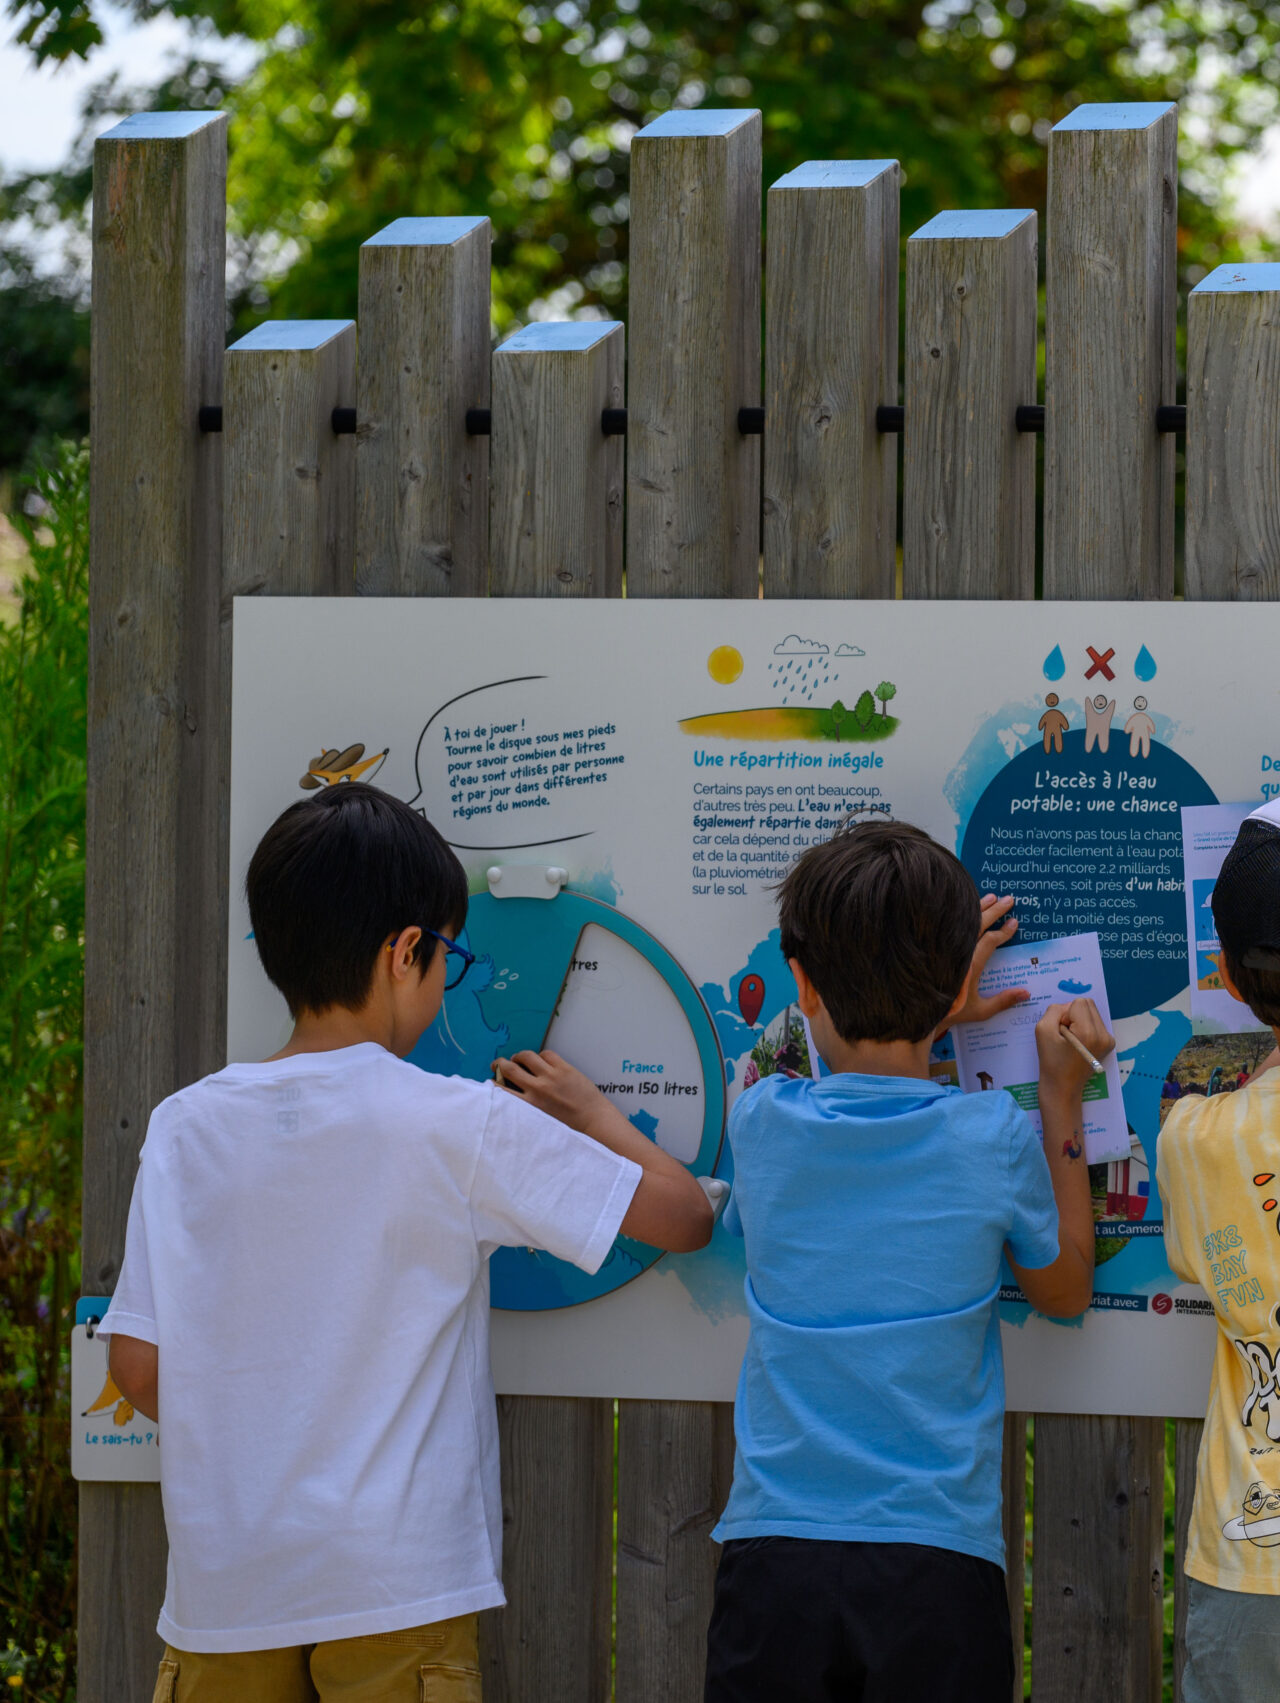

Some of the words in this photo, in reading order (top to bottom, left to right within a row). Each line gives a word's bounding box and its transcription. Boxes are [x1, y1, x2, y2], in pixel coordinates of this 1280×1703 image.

[444, 726, 451, 742] À
[455, 727, 470, 741] toi
[474, 726, 487, 738] de
[489, 724, 518, 740] jouer
[521, 718, 525, 731] !
[445, 744, 482, 756] Tourne
[486, 740, 495, 751] le
[499, 737, 532, 750] disque
[536, 732, 559, 744] sous
[563, 729, 584, 740] mes
[588, 723, 616, 738] pieds
[448, 761, 472, 774] pour
[477, 755, 508, 768] savoir
[513, 748, 556, 762] combien
[560, 745, 573, 756] de
[577, 742, 606, 754] litres
[694, 750, 724, 767] Une
[730, 751, 822, 770] répartition
[828, 751, 884, 773] inégale
[450, 776, 478, 788] d'eau
[482, 769, 506, 783] sont
[511, 764, 548, 778] utilisés
[552, 762, 570, 775] par
[574, 754, 624, 770] personne
[451, 791, 463, 802] et
[467, 789, 486, 802] par
[489, 785, 511, 802] jour
[515, 782, 539, 794] dans
[543, 772, 607, 790] différentes
[1035, 771, 1096, 788] L'accès
[1102, 770, 1111, 788] à
[1118, 771, 1157, 789] l'eau
[693, 783, 743, 796] Certains
[746, 786, 774, 798] pays
[776, 786, 792, 796] en
[795, 784, 815, 796] ont
[818, 784, 882, 798] beaucoup,
[453, 803, 492, 820] régions
[496, 799, 508, 812] du
[512, 795, 550, 809] monde.
[693, 800, 740, 812] d'autres
[744, 800, 766, 812] très
[769, 803, 795, 814] peu.
[798, 799, 830, 812] L'eau
[834, 799, 866, 812] n'est
[870, 802, 892, 817] pas
[1087, 801, 1115, 812] une
[1121, 796, 1178, 812] chance
[693, 814, 756, 831] également
[760, 815, 811, 829] répartie
[815, 814, 842, 829] dans
[693, 835, 710, 845] car
[714, 833, 740, 845] cela
[743, 833, 790, 847] dépend
[793, 834, 809, 846] du
[991, 827, 1023, 839] Nous
[1027, 827, 1072, 839] n'avons
[1075, 830, 1098, 842] pas
[1100, 828, 1127, 840] tous
[1130, 828, 1141, 840] la
[1144, 828, 1183, 840] chanc
[693, 851, 704, 861] et
[708, 850, 724, 861] de
[727, 850, 737, 862] la
[740, 850, 790, 865] quantité
[985, 843, 1046, 856] d'accéder
[1048, 844, 1113, 857] facilement
[1116, 845, 1124, 857] à
[1127, 845, 1156, 858] l'eau
[1158, 846, 1184, 860] pota
[692, 866, 706, 878] (la
[710, 866, 788, 881] pluviométrie)
[981, 860, 1050, 875] Aujourd'hui
[1053, 864, 1096, 874] encore
[1119, 862, 1171, 874] milliards
[692, 886, 711, 895] sur
[714, 883, 725, 895] le
[728, 883, 747, 895] sol.
[980, 877, 997, 889] de
[1000, 880, 1068, 892] personnes,
[1071, 879, 1092, 891] soit
[1097, 879, 1122, 893] près
[1126, 878, 1152, 891] d'un
[1044, 896, 1060, 910] n'y
[1063, 898, 1072, 908] a
[1074, 898, 1097, 910] pas
[1100, 895, 1137, 908] accès.
[1033, 912, 1049, 923] de
[1052, 912, 1063, 924] la
[1067, 912, 1105, 925] moitié
[1107, 913, 1131, 925] des
[1134, 916, 1164, 928] gens
[1017, 928, 1048, 940] Terre
[1122, 932, 1143, 944] pas
[1146, 930, 1188, 945] d'égou
[1131, 947, 1154, 959] des
[1157, 950, 1188, 960] eaux
[572, 957, 599, 972] tres
[622, 1060, 664, 1074] France
[638, 1082, 660, 1094] 150
[664, 1081, 698, 1096] litres
[1102, 1226, 1116, 1235] au
[1118, 1224, 1164, 1235] Camerou
[1202, 1224, 1242, 1260] SK8
[1211, 1250, 1248, 1286] BAY
[1112, 1299, 1139, 1308] avec
[1174, 1298, 1215, 1310] SOLIDARI
[1176, 1308, 1216, 1317] INTERNATION
[85, 1432, 98, 1444] Le
[102, 1433, 143, 1446] sais-tu
[146, 1432, 153, 1445] ?
